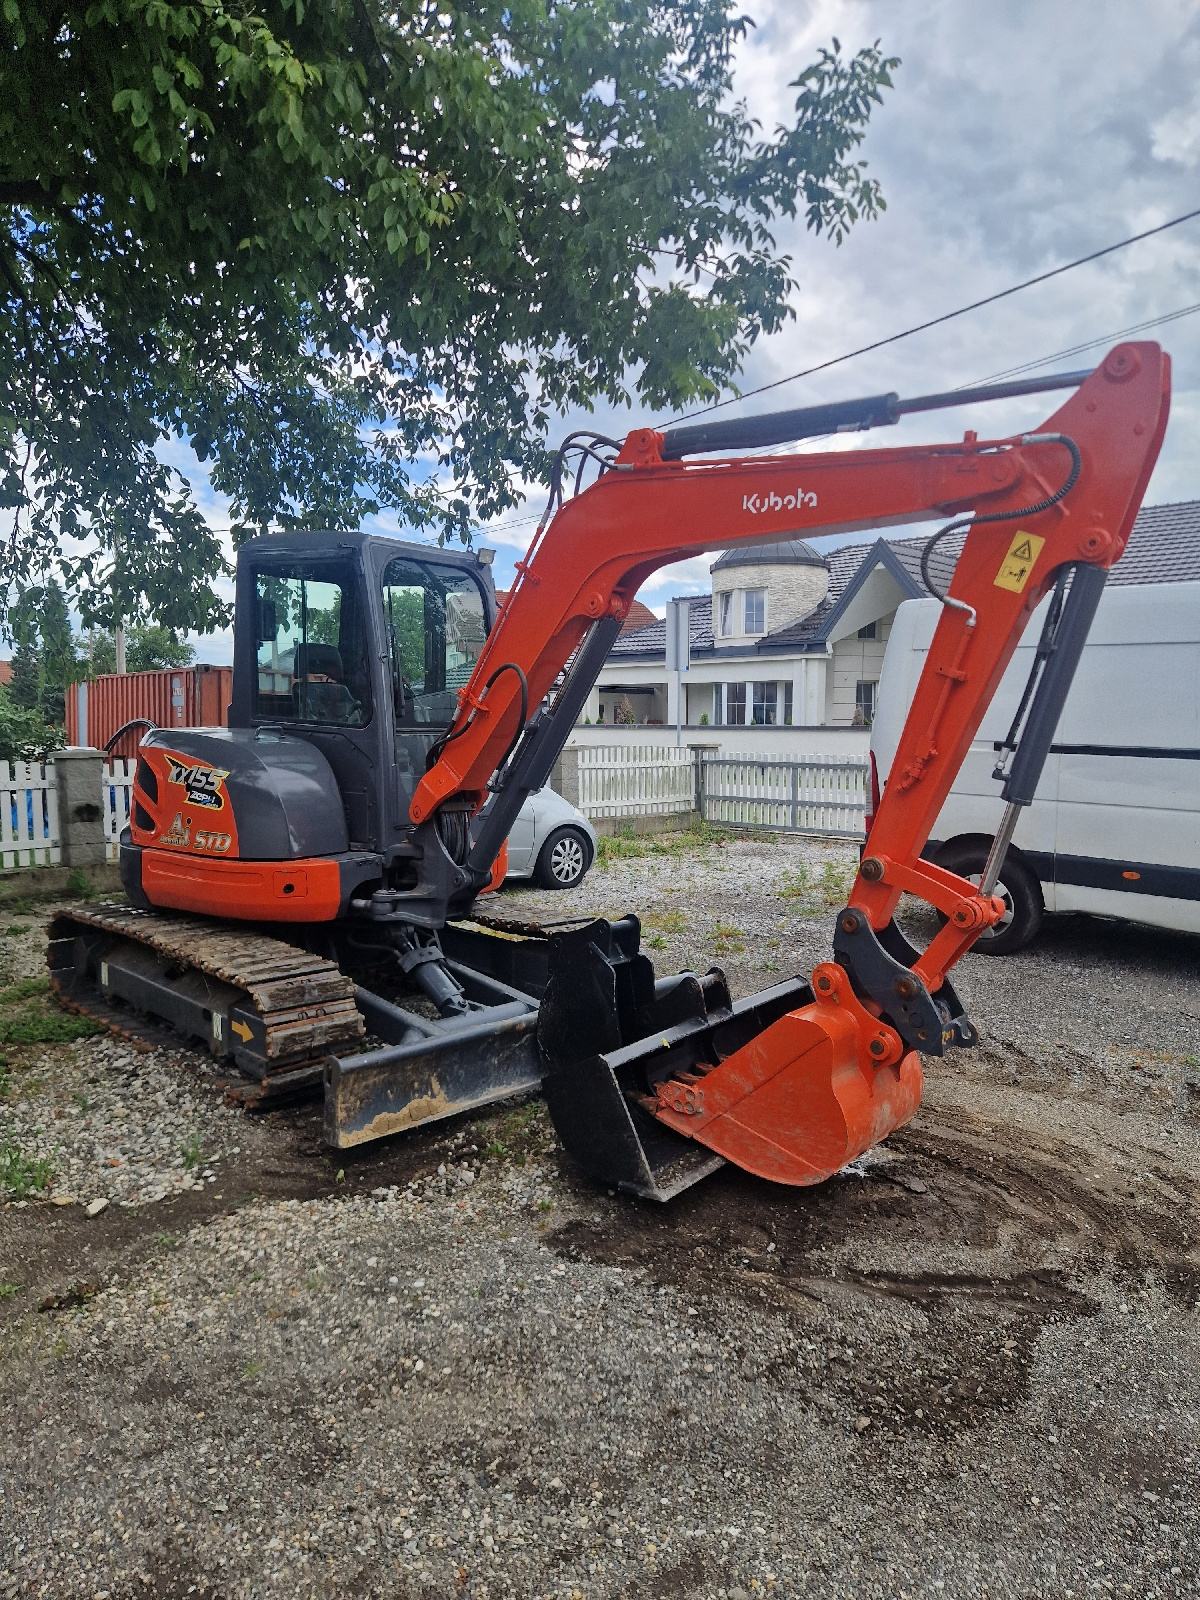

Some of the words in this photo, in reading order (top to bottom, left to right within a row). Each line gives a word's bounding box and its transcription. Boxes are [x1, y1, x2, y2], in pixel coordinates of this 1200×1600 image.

[742, 487, 818, 514] Kubota
[169, 765, 229, 791] KX155
[193, 829, 232, 853] STD
